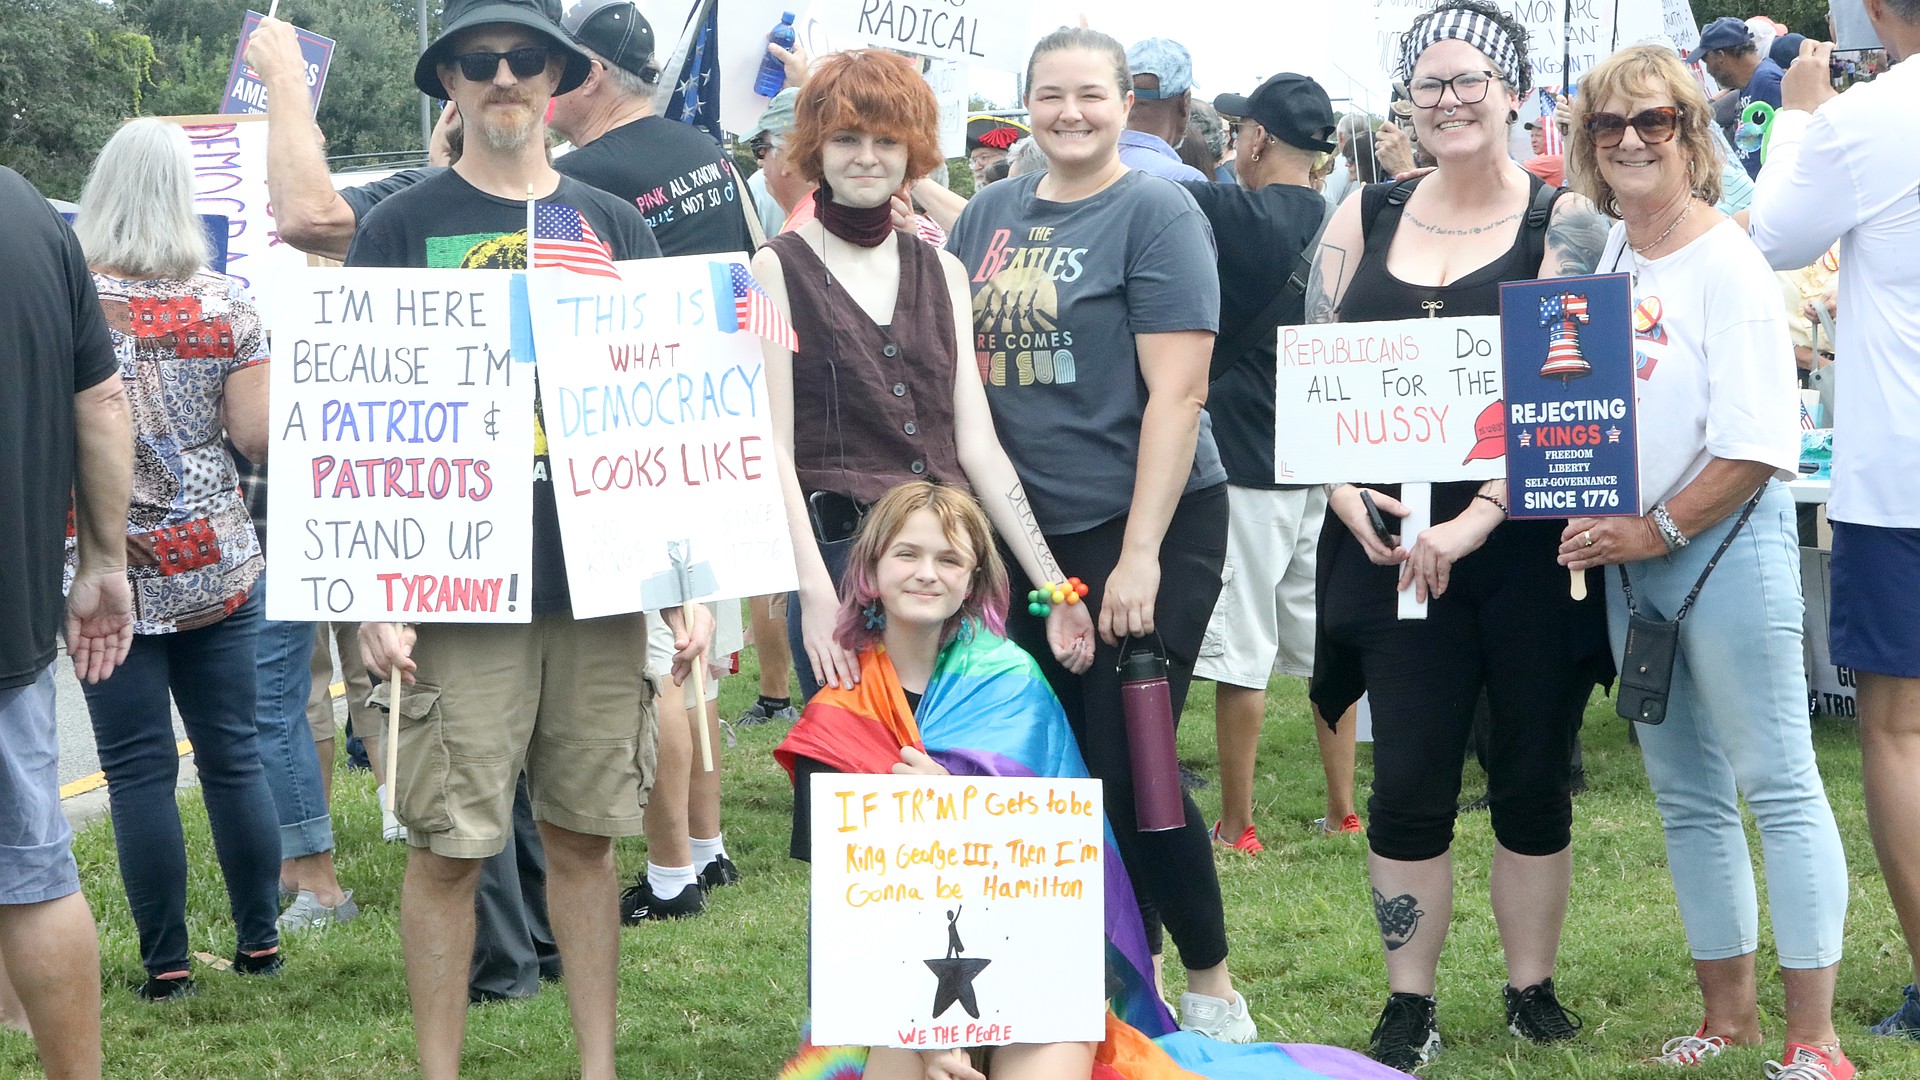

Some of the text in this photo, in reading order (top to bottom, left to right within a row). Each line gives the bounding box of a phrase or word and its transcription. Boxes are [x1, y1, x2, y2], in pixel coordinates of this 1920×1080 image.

[858, 0, 985, 57] RADICAL
[636, 187, 669, 214] PINK
[669, 177, 692, 199] ALL
[681, 193, 704, 215] NOT
[707, 188, 721, 207] SO
[1028, 227, 1054, 241] THE
[972, 229, 1088, 283] BEATLES
[313, 285, 488, 328] I'M HERE
[557, 289, 704, 337] THIS IS
[609, 342, 681, 372] WHAT
[977, 331, 1073, 350] RE COMES
[1283, 328, 1420, 367] REPUBLICANS
[293, 339, 511, 386] BECAUSE I'M
[1016, 349, 1076, 386] SUN
[559, 363, 763, 437] DEMOCRACY
[1307, 367, 1498, 403] ALL FOR THE
[282, 400, 502, 443] A PATRIOT &
[1336, 404, 1450, 446] NUSSY
[1511, 398, 1627, 425] REJECTING
[1536, 423, 1601, 447] KINGS
[568, 436, 762, 497] LOOKS LIKE
[1545, 449, 1594, 460] FREEDOM
[1548, 462, 1590, 473] LIBERTY
[312, 455, 493, 502] PATRIOTS
[1524, 475, 1618, 488] SELF-GOVERNANCE
[1524, 488, 1620, 509] SINCE 1776
[304, 517, 494, 560] STAND UP
[1005, 482, 1064, 585] DEMOCRAC
[301, 573, 519, 613] TO TYRANNY!
[834, 791, 879, 833] IF
[984, 791, 1039, 817] Gets
[846, 843, 887, 876] King
[896, 840, 959, 870] George
[1006, 838, 1047, 868] Then
[1054, 838, 1099, 867] I'm
[845, 874, 1083, 908] Gonna be Hamilton
[898, 1023, 1012, 1045] WE THE PEOPLE
